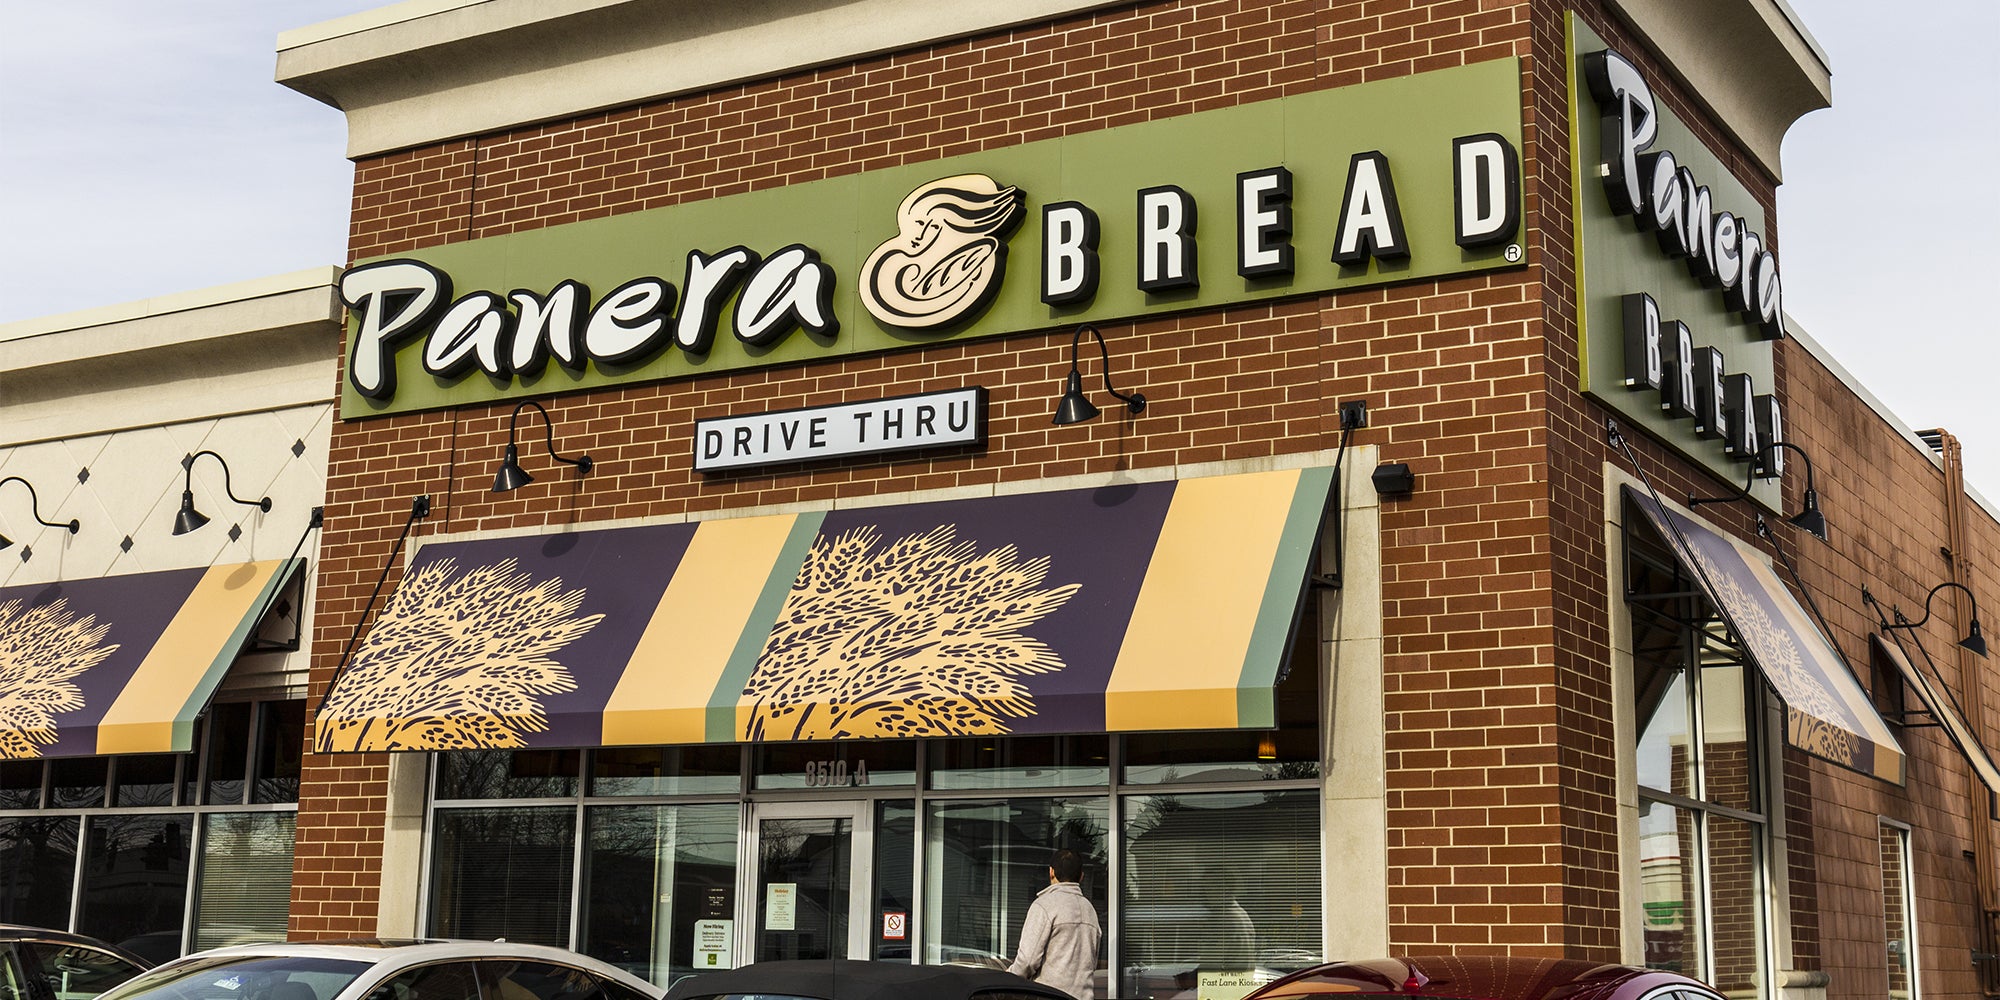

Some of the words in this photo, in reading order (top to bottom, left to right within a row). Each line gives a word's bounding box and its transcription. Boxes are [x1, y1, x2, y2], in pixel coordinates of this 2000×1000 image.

[1605, 48, 1785, 339] Panera
[341, 245, 832, 396] Panera
[1044, 136, 1514, 301] BREAD
[704, 416, 828, 460] DRIVE
[853, 400, 969, 443] THRU
[1642, 291, 1784, 478] BREAD
[805, 760, 847, 786] 8510
[855, 759, 868, 785] A
[1201, 978, 1218, 987] Fast
[1218, 978, 1238, 987] Lane
